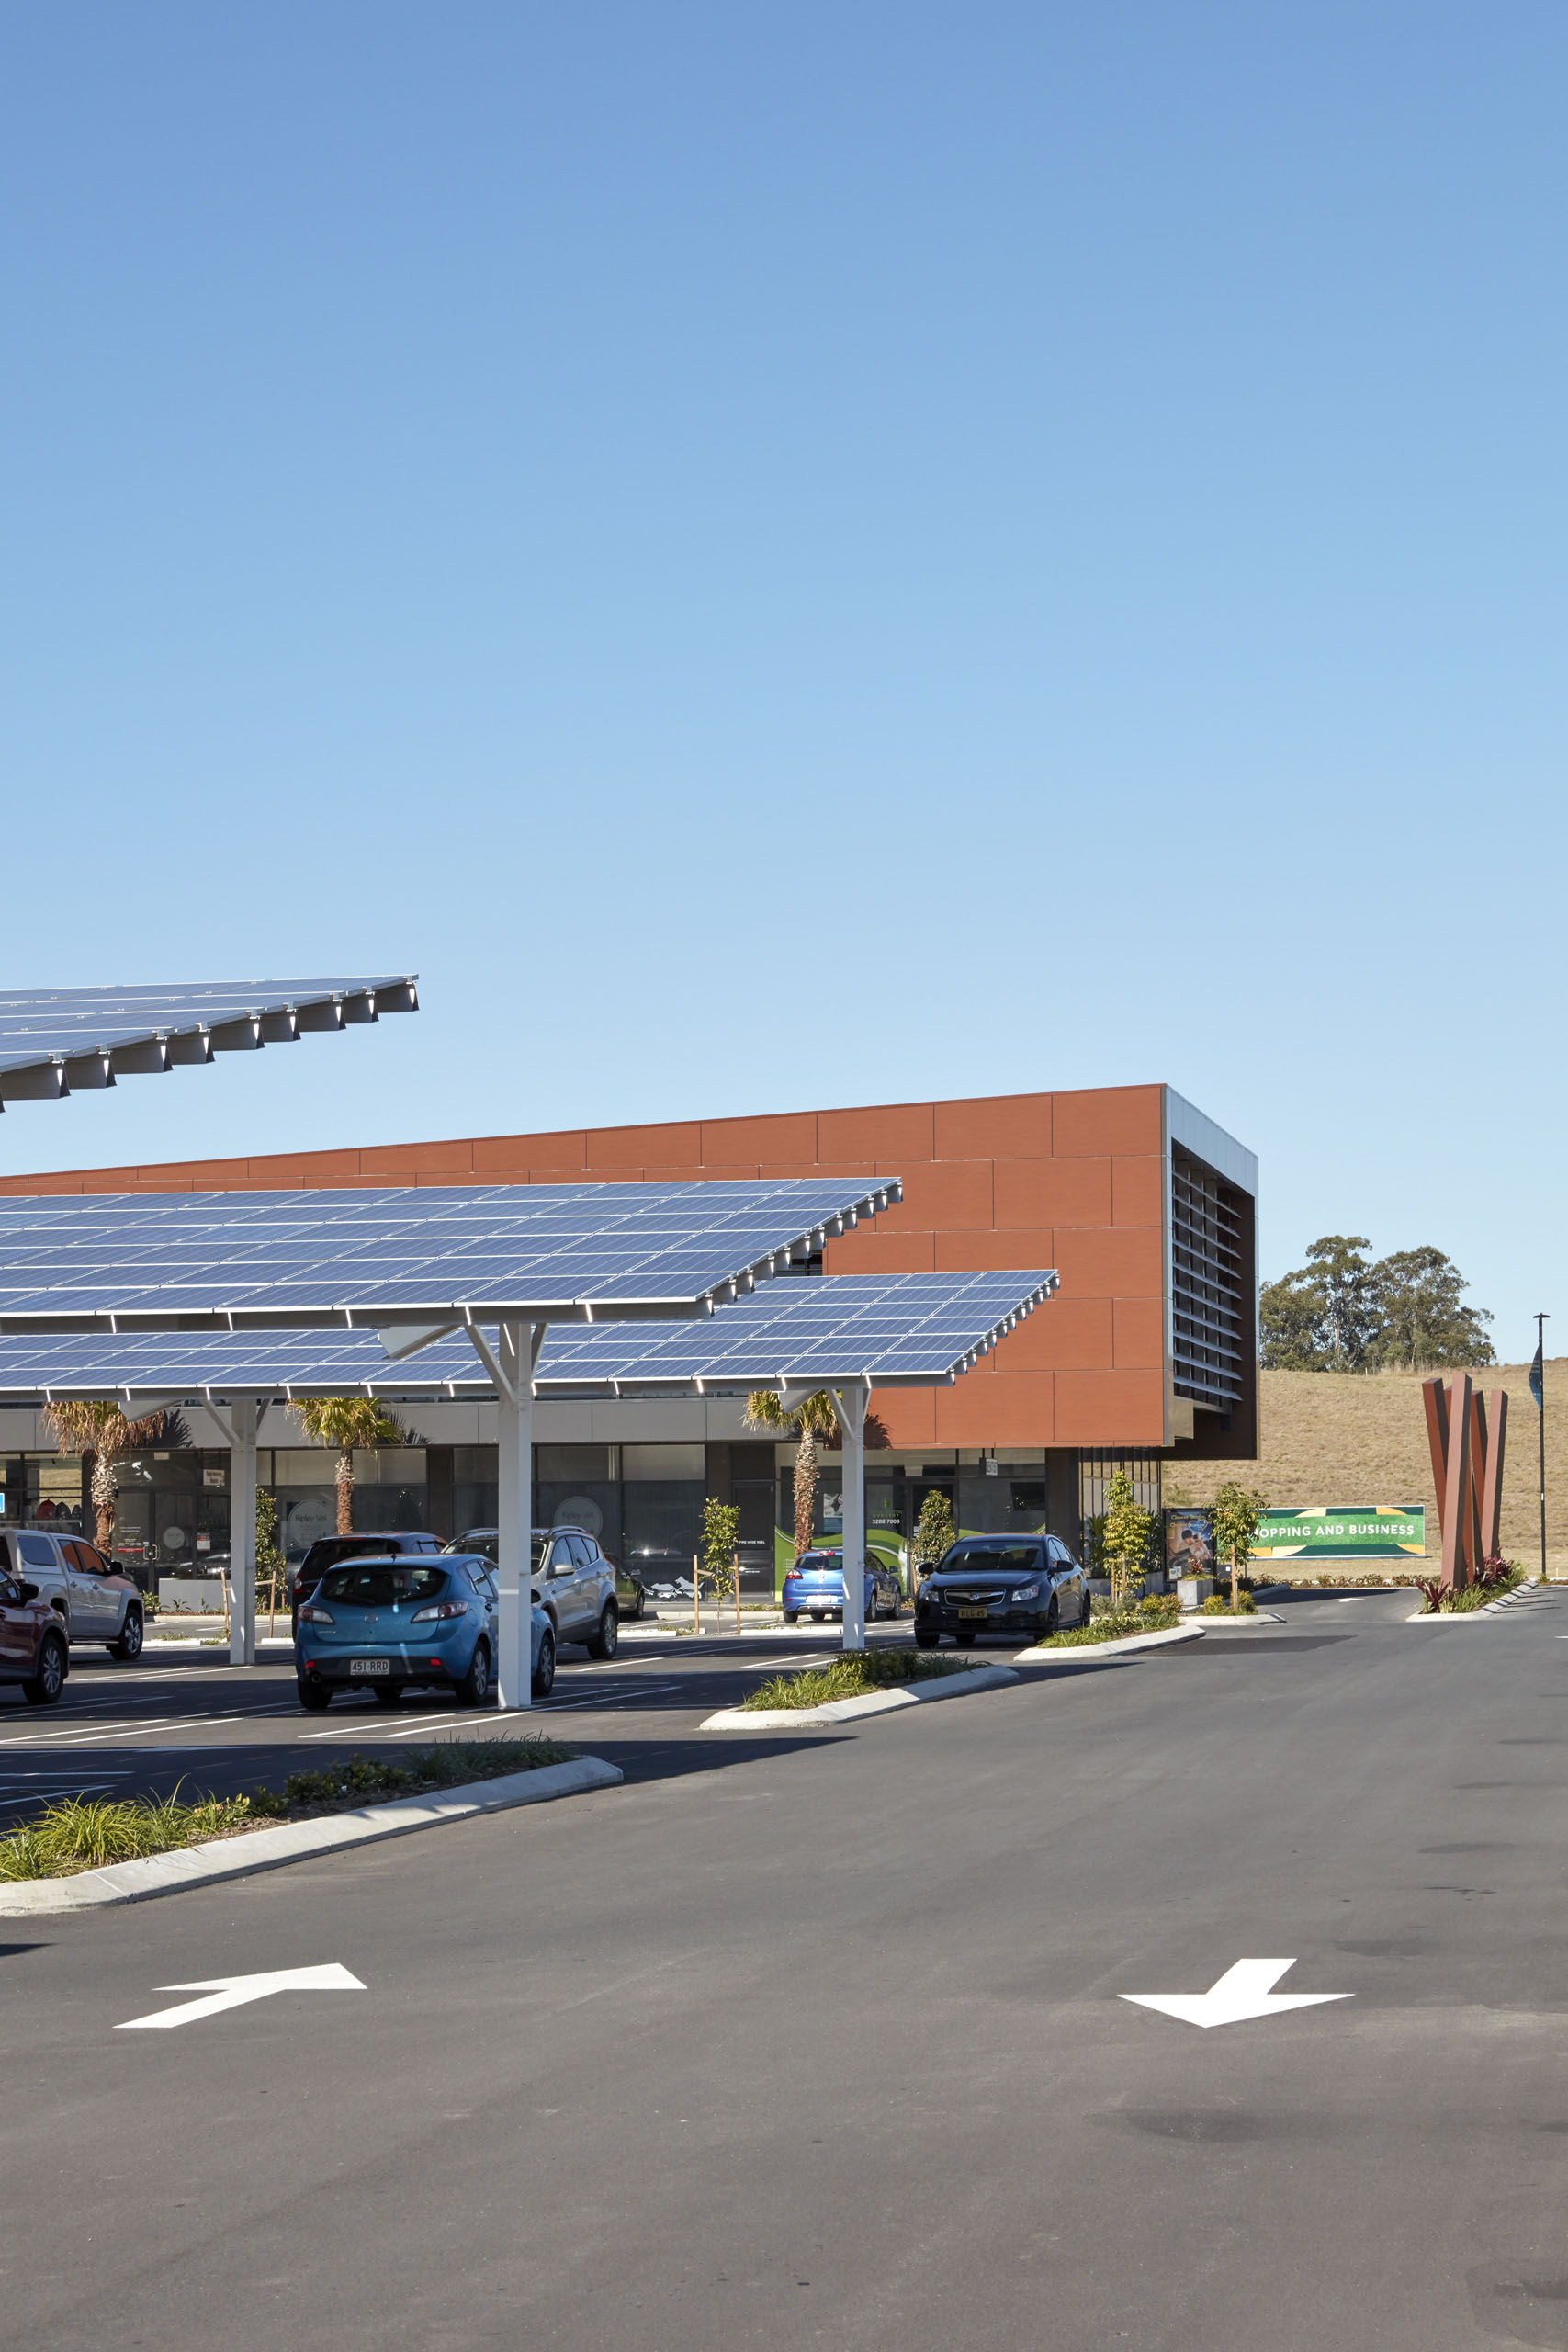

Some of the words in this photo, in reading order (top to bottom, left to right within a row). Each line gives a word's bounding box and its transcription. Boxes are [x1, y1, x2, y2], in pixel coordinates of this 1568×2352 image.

[1253, 1525, 1311, 1538] OPPING
[1315, 1525, 1344, 1536] AND
[1349, 1524, 1415, 1536] BUSINESS
